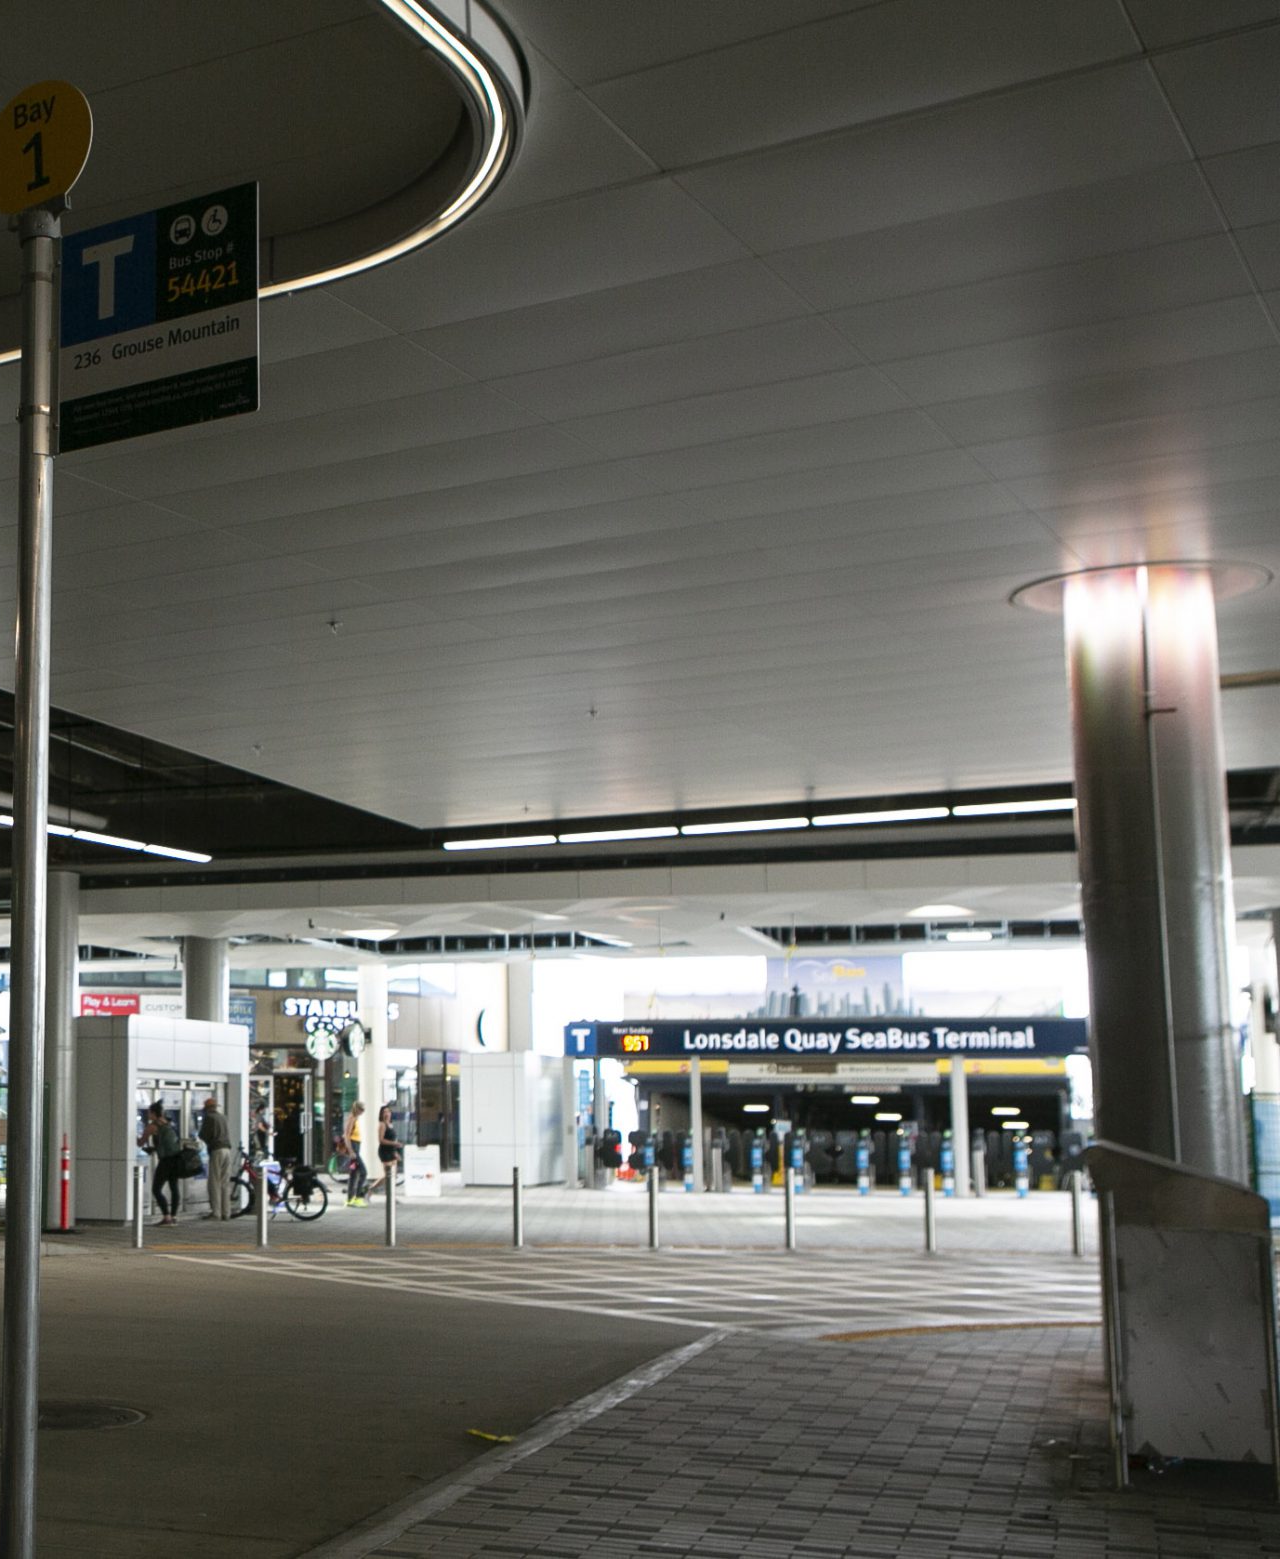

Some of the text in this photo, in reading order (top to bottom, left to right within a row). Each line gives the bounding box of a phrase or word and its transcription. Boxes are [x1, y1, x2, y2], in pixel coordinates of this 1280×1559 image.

[14, 95, 55, 129] Bay
[22, 131, 50, 191] 1
[169, 240, 235, 271] Bus Stop #
[81, 234, 135, 320] T
[166, 261, 240, 303] 54421
[73, 315, 240, 370] 236 Grouse Mountain
[571, 1028, 591, 1051] T
[683, 1026, 1036, 1054] Lonsdale Quay SeaBus Terminal
